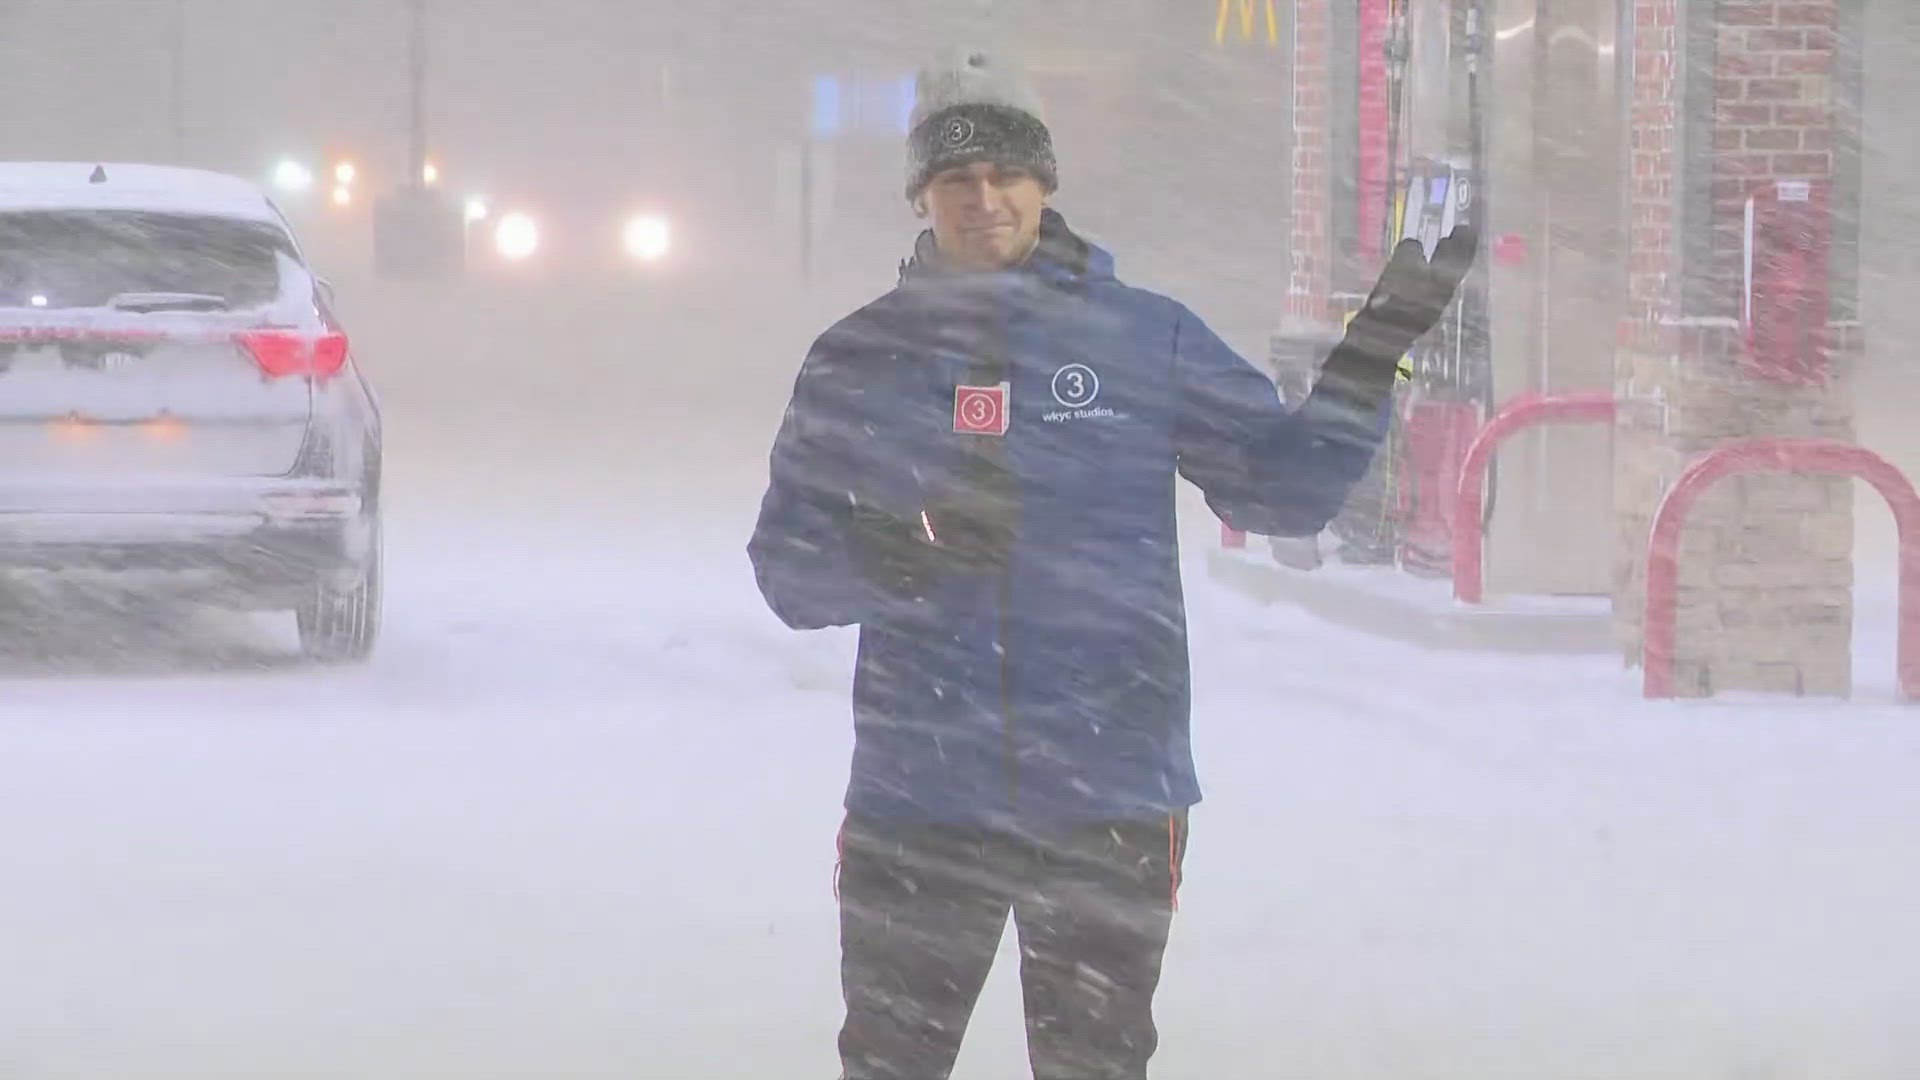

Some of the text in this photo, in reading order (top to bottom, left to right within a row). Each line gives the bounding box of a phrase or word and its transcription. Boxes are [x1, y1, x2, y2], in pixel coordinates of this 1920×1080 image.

[1066, 372, 1085, 398] 3
[972, 399, 986, 421] 3
[1042, 406, 1115, 424] wkyc studios
